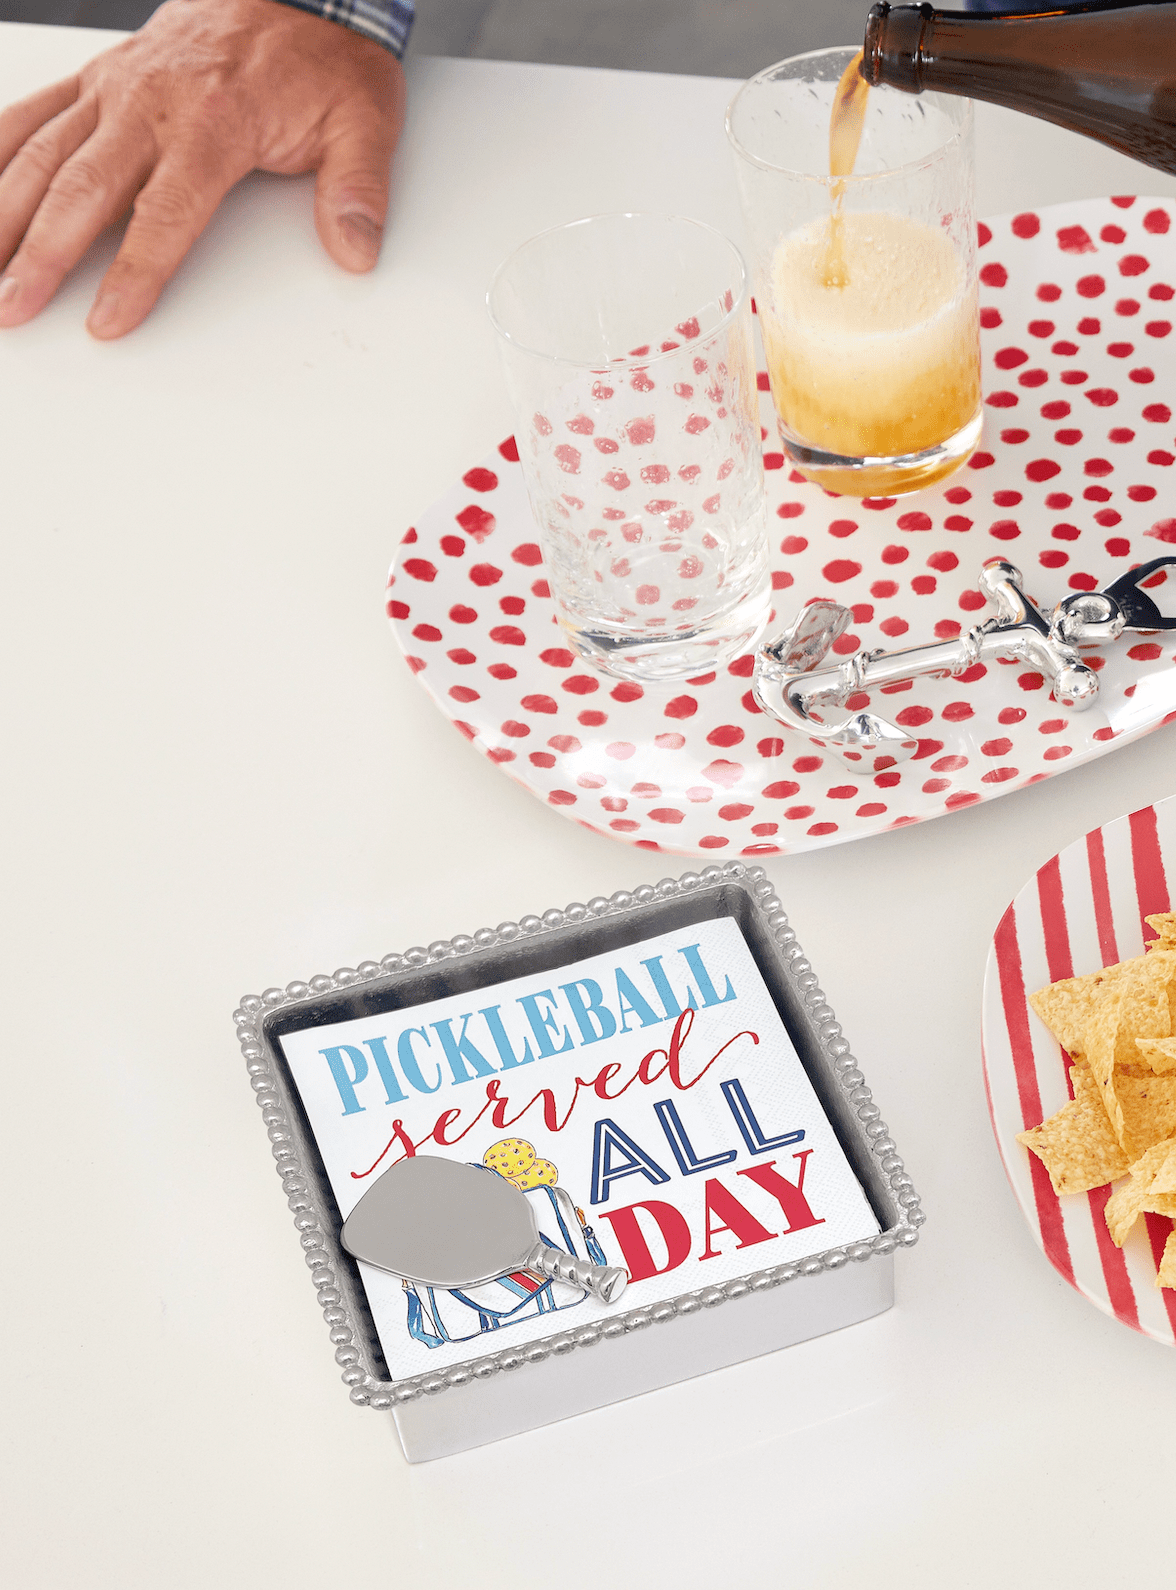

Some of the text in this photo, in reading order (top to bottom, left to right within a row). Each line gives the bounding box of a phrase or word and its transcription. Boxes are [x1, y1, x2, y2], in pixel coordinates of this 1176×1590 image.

[318, 943, 737, 1116] PICKLEBALL
[350, 1008, 759, 1178] served
[590, 1078, 806, 1205] ALL
[598, 1149, 826, 1284] DAY
